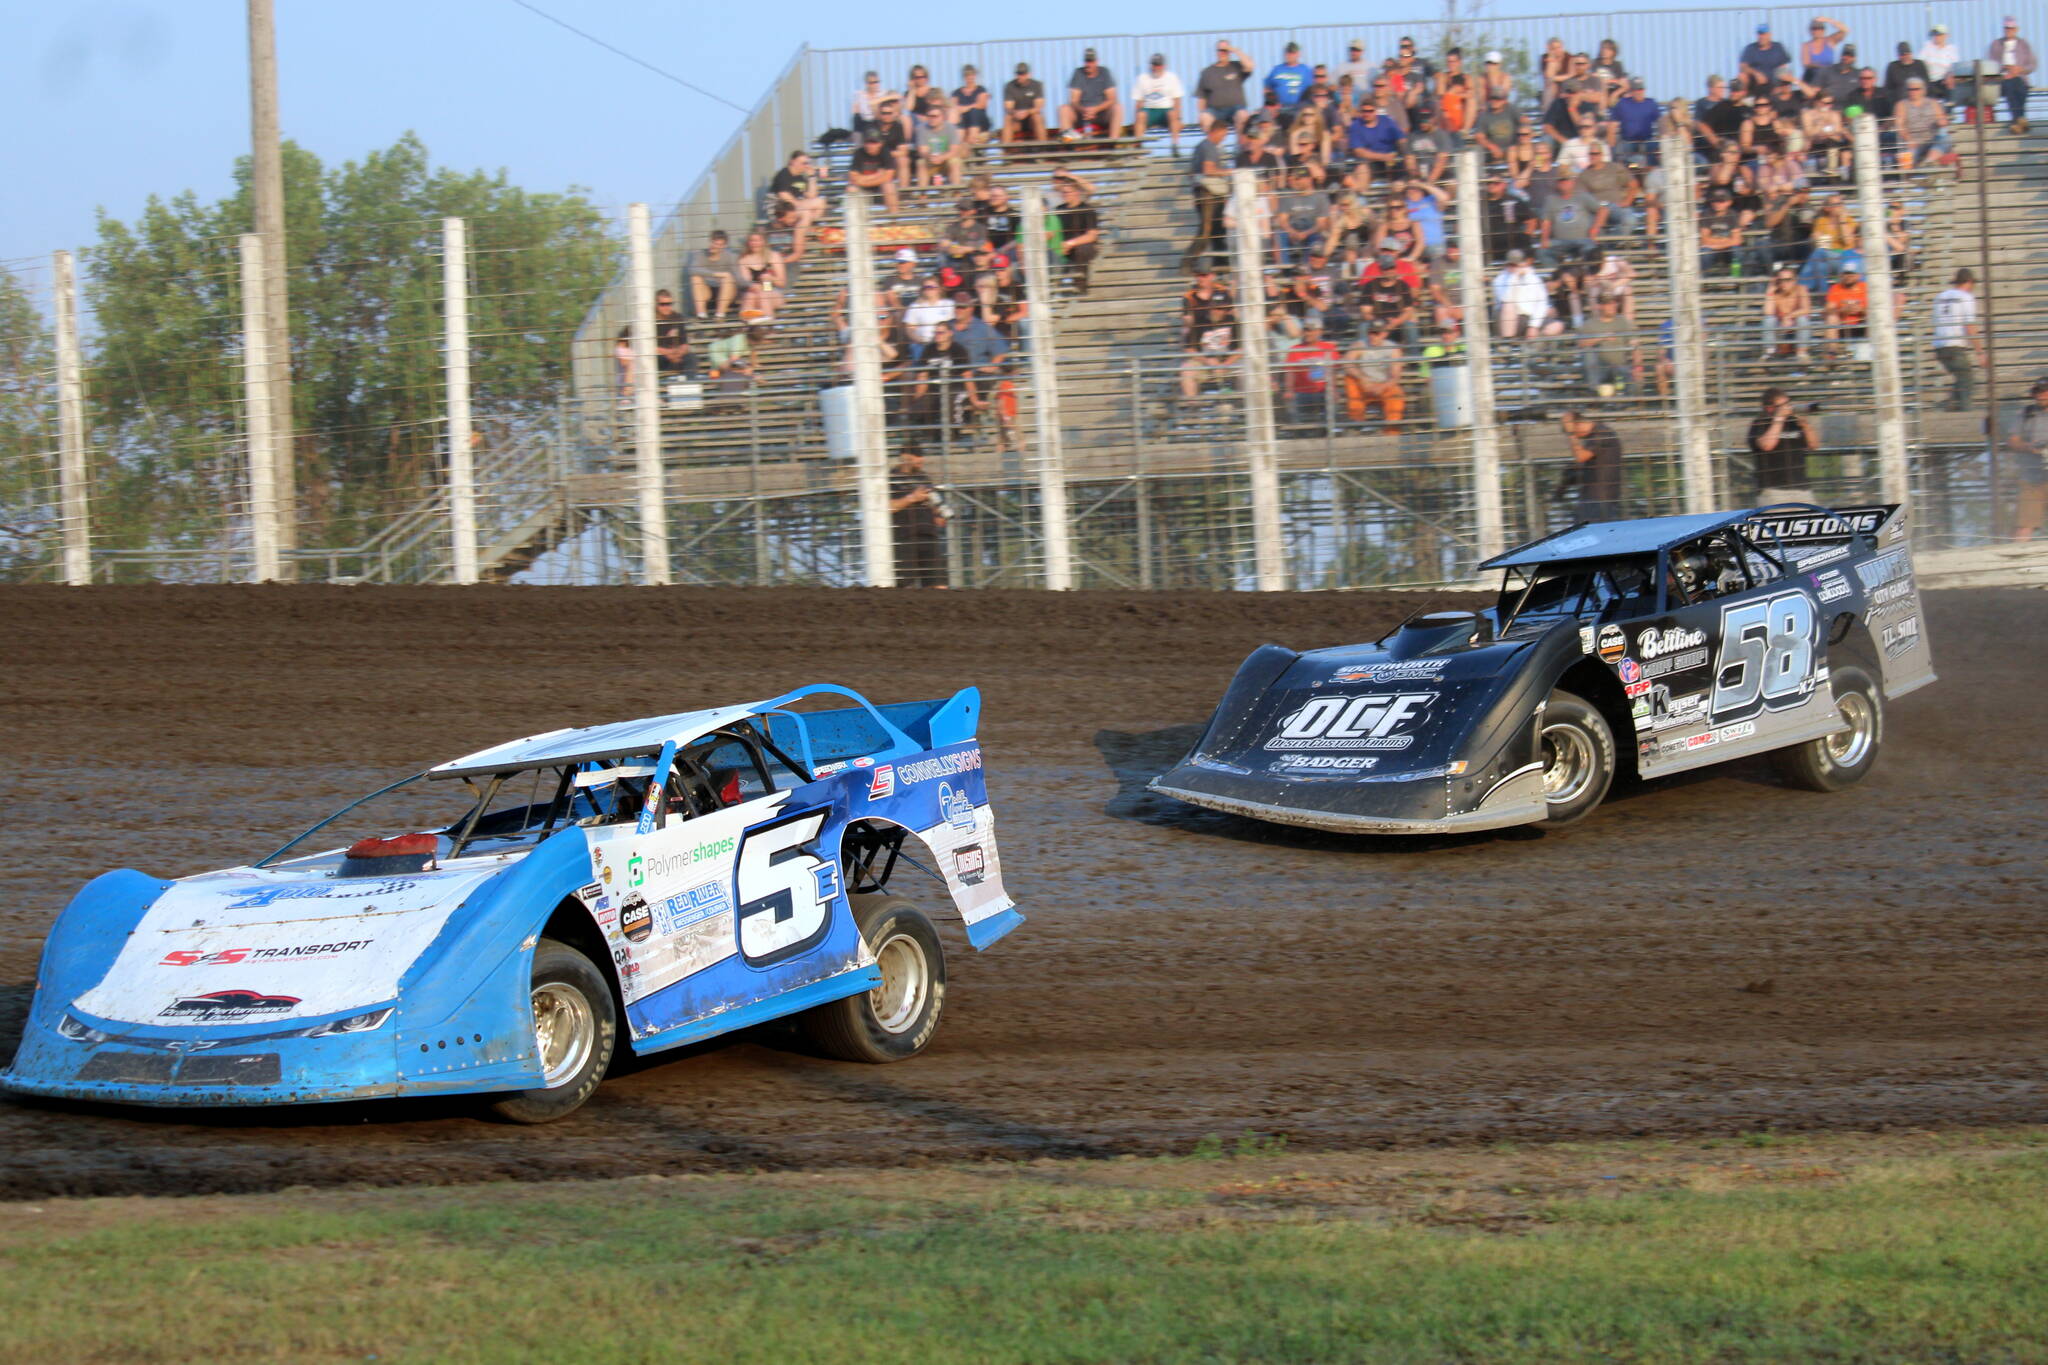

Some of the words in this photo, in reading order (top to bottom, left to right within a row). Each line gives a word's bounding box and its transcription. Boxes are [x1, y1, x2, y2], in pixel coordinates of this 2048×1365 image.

[1762, 514, 1878, 538] CUSTOMS
[1601, 635, 1624, 649] CASE
[1336, 658, 1452, 674] SOUTHWORTH
[1711, 591, 1815, 723] 58
[1394, 669, 1437, 680] GMC
[1280, 694, 1432, 739] OCF
[1289, 755, 1379, 769] BADGER
[647, 837, 735, 880] Polymershapes
[735, 808, 829, 964] 5
[811, 861, 838, 904] E
[667, 893, 691, 916] RED
[691, 882, 723, 909] RIVER
[622, 906, 650, 925] CASE
[253, 939, 374, 959] TRANSPORT
